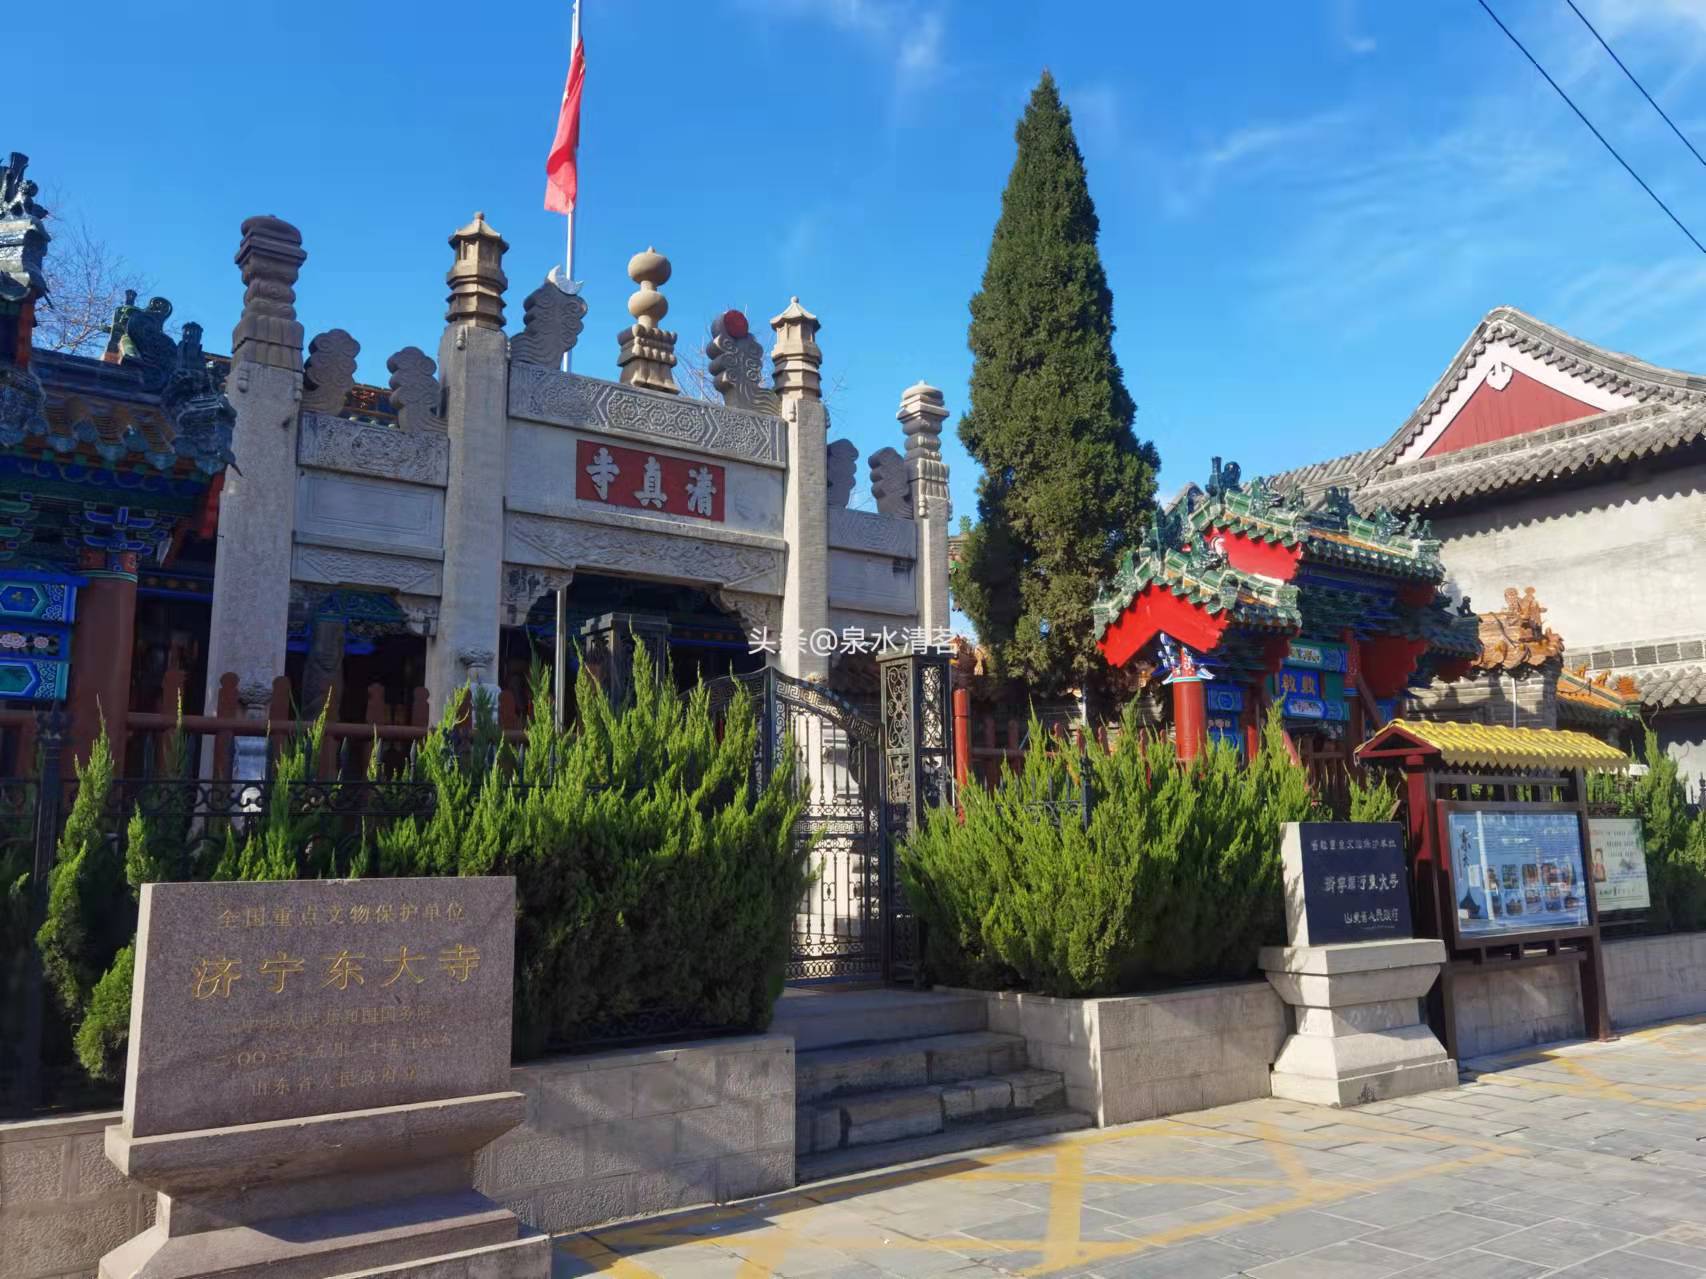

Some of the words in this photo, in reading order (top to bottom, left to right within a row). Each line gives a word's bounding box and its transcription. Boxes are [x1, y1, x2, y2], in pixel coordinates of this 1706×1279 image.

[218, 902, 466, 929] 全国重点文物保护单位
[191, 943, 481, 1000] 济宁东大寺
